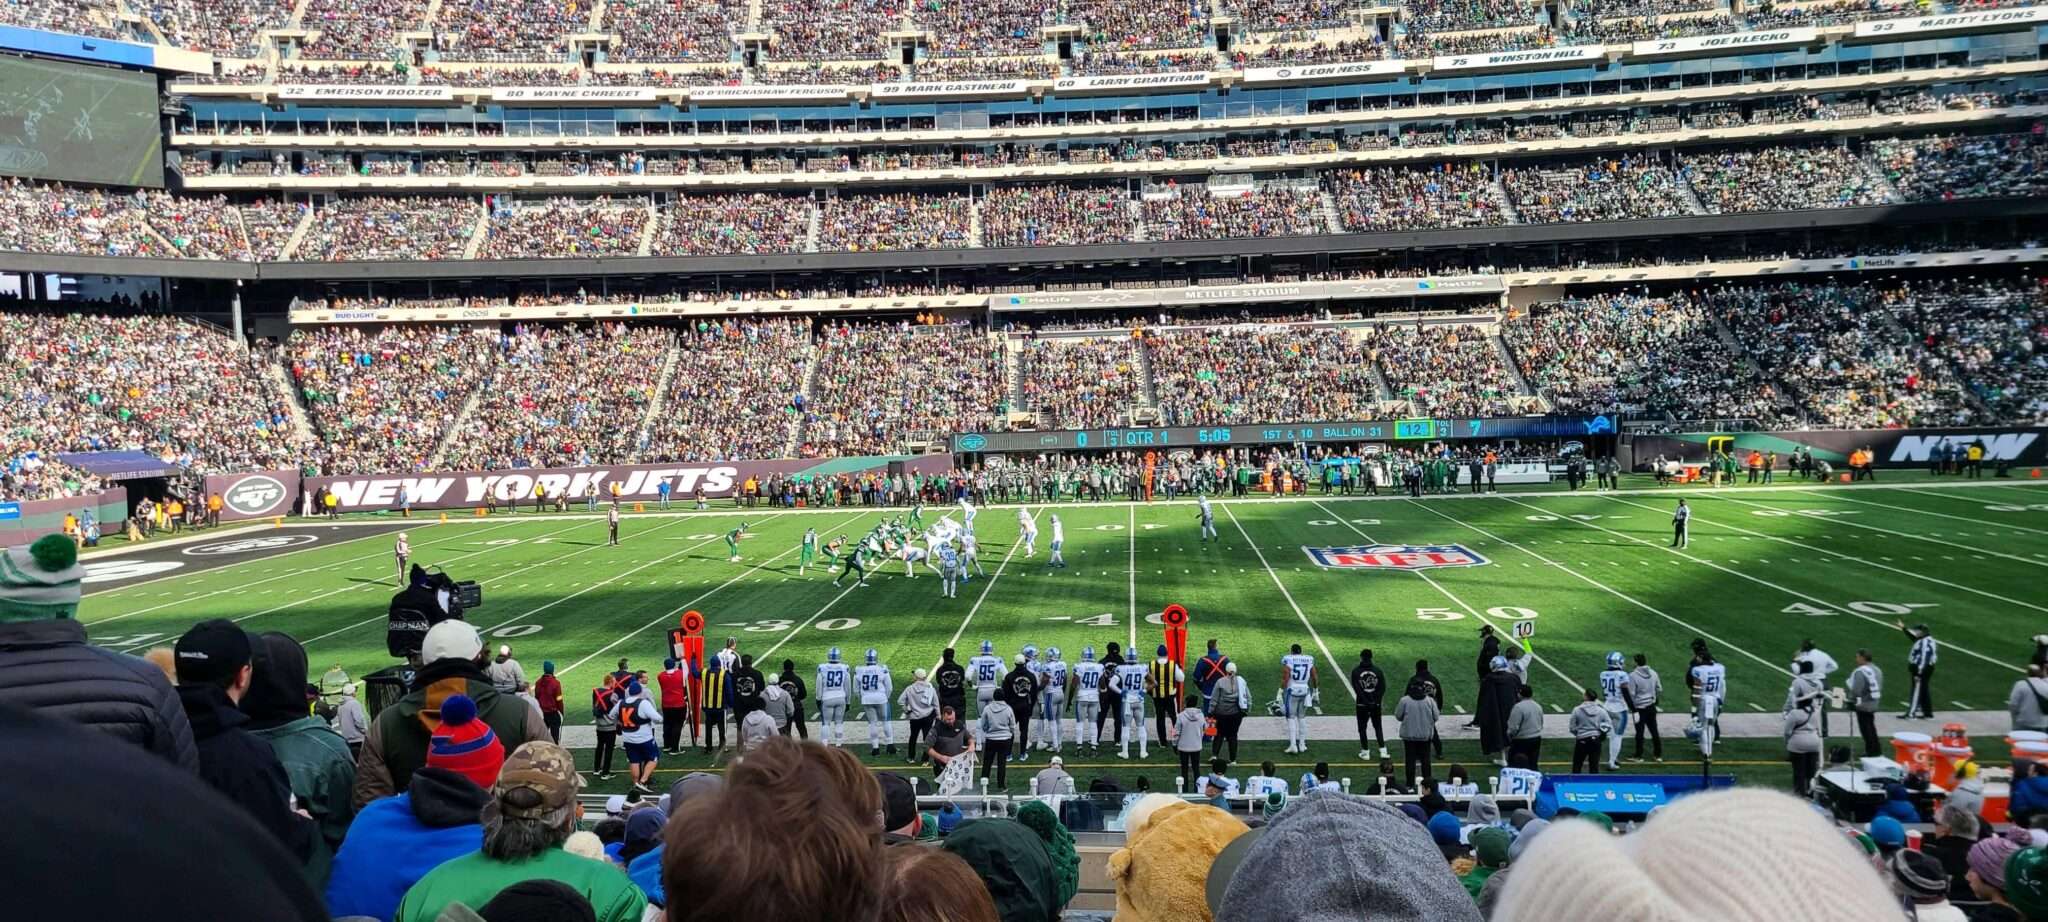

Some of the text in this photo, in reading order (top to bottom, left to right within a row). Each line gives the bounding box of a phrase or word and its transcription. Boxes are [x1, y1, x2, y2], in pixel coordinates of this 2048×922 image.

[1872, 10, 2036, 31] 93 MARTY LYONS
[1658, 33, 1789, 50] 73 JOE KLECKO
[1452, 50, 1584, 66] 75 WINSTON HILL
[1301, 66, 1335, 76] LEON
[946, 83, 1016, 91] GASTINEAU
[1090, 78, 1130, 86] LARRY
[315, 88, 383, 96] EMERSON
[1437, 280, 1484, 288] MetLife
[1184, 287, 1300, 299] METLIFE STADIUM
[1199, 429, 1231, 442] 5:05
[1263, 430, 1281, 440] 1ST
[1301, 429, 1313, 438] 10
[1323, 427, 1382, 437] BALL ON 31
[1406, 425, 1422, 435] 12
[1469, 420, 1481, 436] 7
[1126, 431, 1168, 444] QTR 1
[329, 467, 738, 507] NEW YORK JETS
[1333, 553, 1468, 566] NFL
[389, 621, 430, 631] CHAPMAN
[1516, 622, 1532, 636] 10
[827, 671, 843, 688] 93
[979, 664, 995, 681] 95
[1292, 664, 1308, 680] 57
[862, 674, 878, 690] 94
[1082, 672, 1098, 688] 40
[1124, 674, 1142, 691] 49
[1602, 678, 1616, 696] 24
[1706, 676, 1720, 692] 51
[621, 707, 635, 727] K
